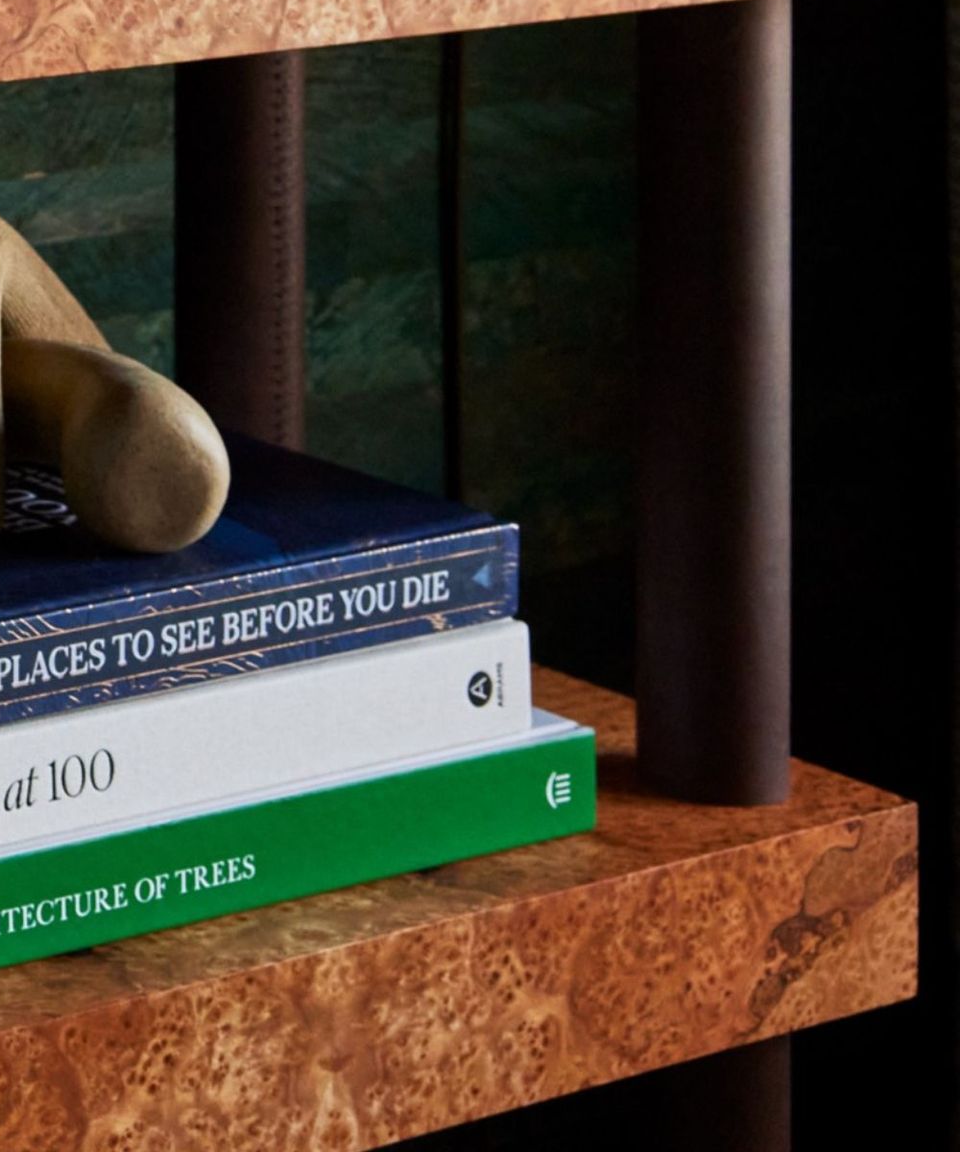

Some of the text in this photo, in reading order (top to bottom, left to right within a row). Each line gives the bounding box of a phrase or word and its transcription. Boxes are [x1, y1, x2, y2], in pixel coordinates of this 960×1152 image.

[111, 629, 154, 667] TO
[160, 616, 217, 656] SEE
[222, 592, 334, 646] BEFORE
[339, 582, 397, 620] YOU
[402, 570, 451, 607] DIE
[3, 765, 38, 812] at
[48, 748, 116, 802] 100
[134, 874, 170, 904] OF
[174, 854, 257, 891] TREES
